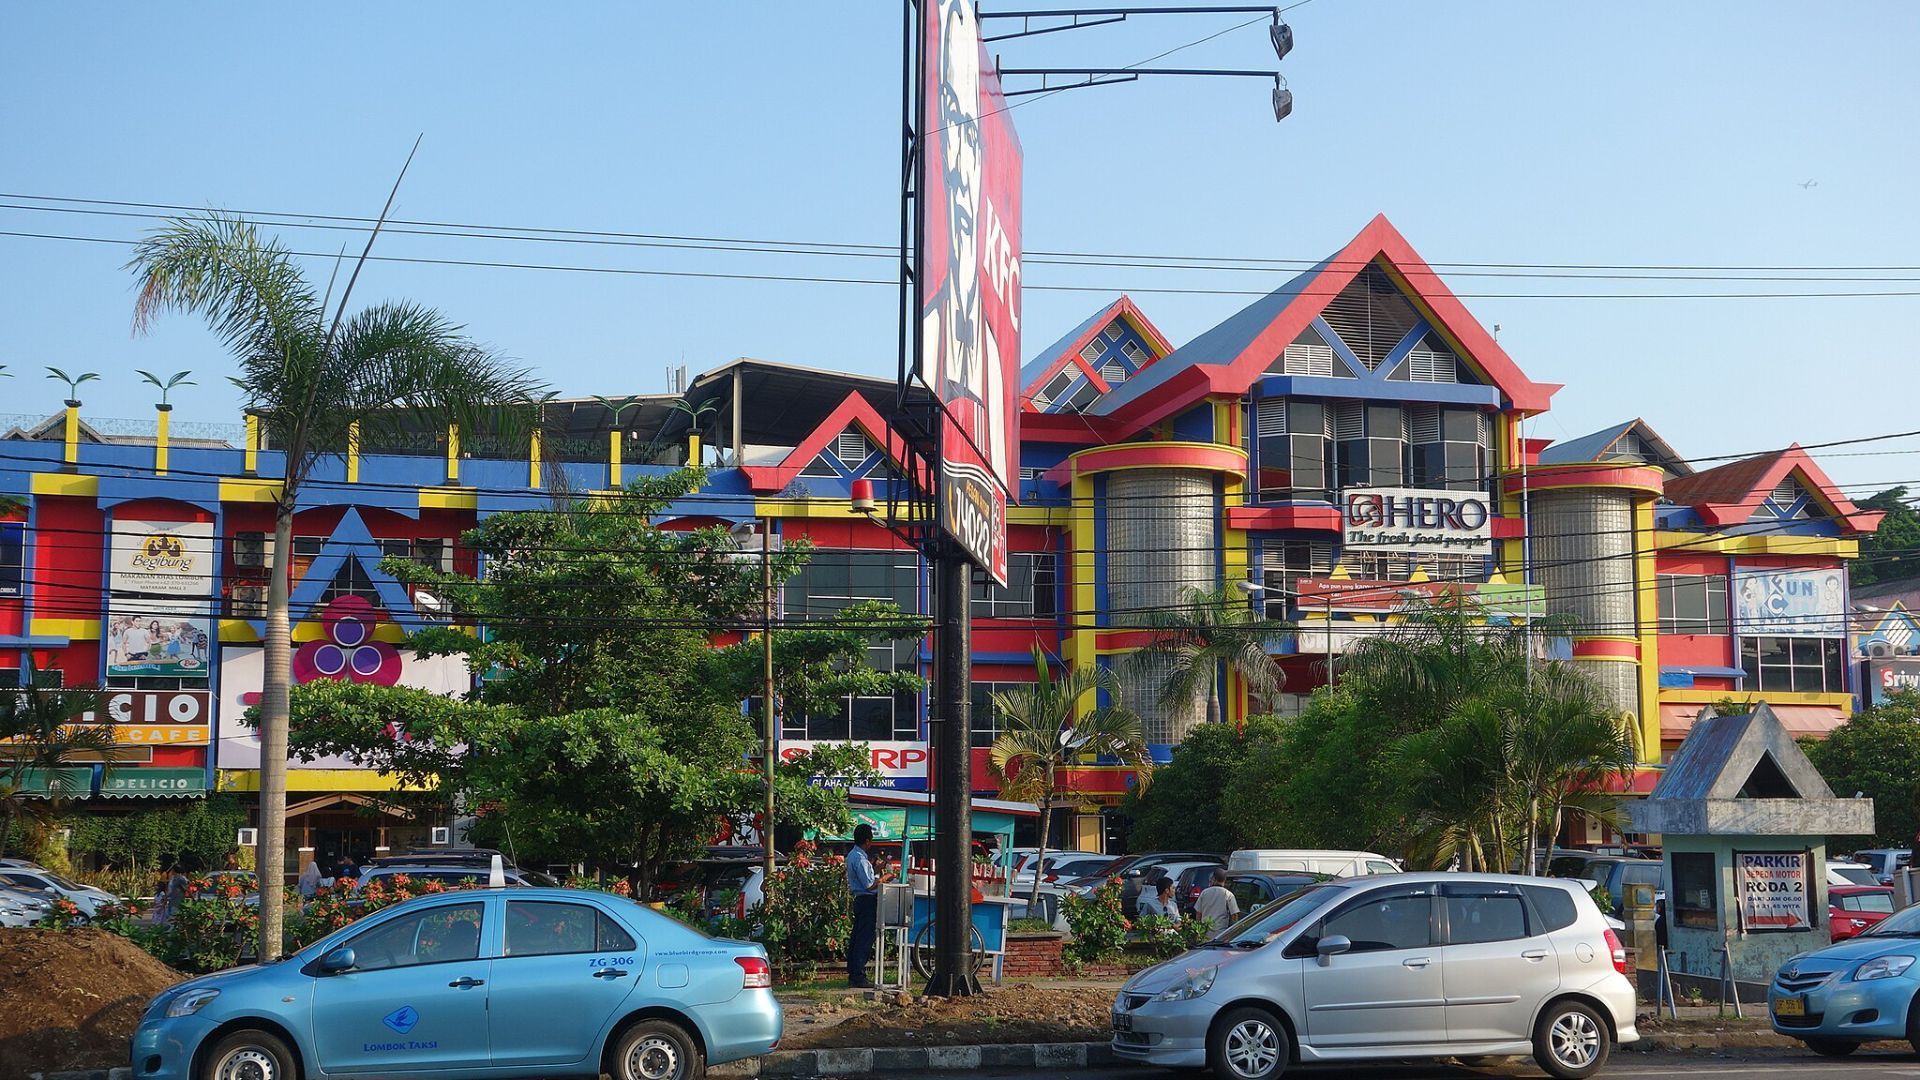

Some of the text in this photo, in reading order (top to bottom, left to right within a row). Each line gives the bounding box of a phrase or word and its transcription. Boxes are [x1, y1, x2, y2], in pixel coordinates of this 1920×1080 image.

[983, 194, 1020, 334] KFC
[1384, 495, 1488, 531] HERO
[955, 487, 990, 568] 14022
[1349, 530, 1488, 549] The fresh food people
[132, 554, 192, 572] Begibung
[1883, 670, 1920, 687] Sriw
[128, 729, 201, 742] CAFE
[780, 747, 927, 770] SRP
[115, 777, 188, 790] DELICIO
[1744, 855, 1801, 868] PARKIR
[1746, 870, 1801, 879] SEPEDA MOTOR
[1746, 881, 1803, 893] RODA 2
[589, 956, 635, 967] ZG 306
[363, 1041, 438, 1052] LOMBOK TAKSI
